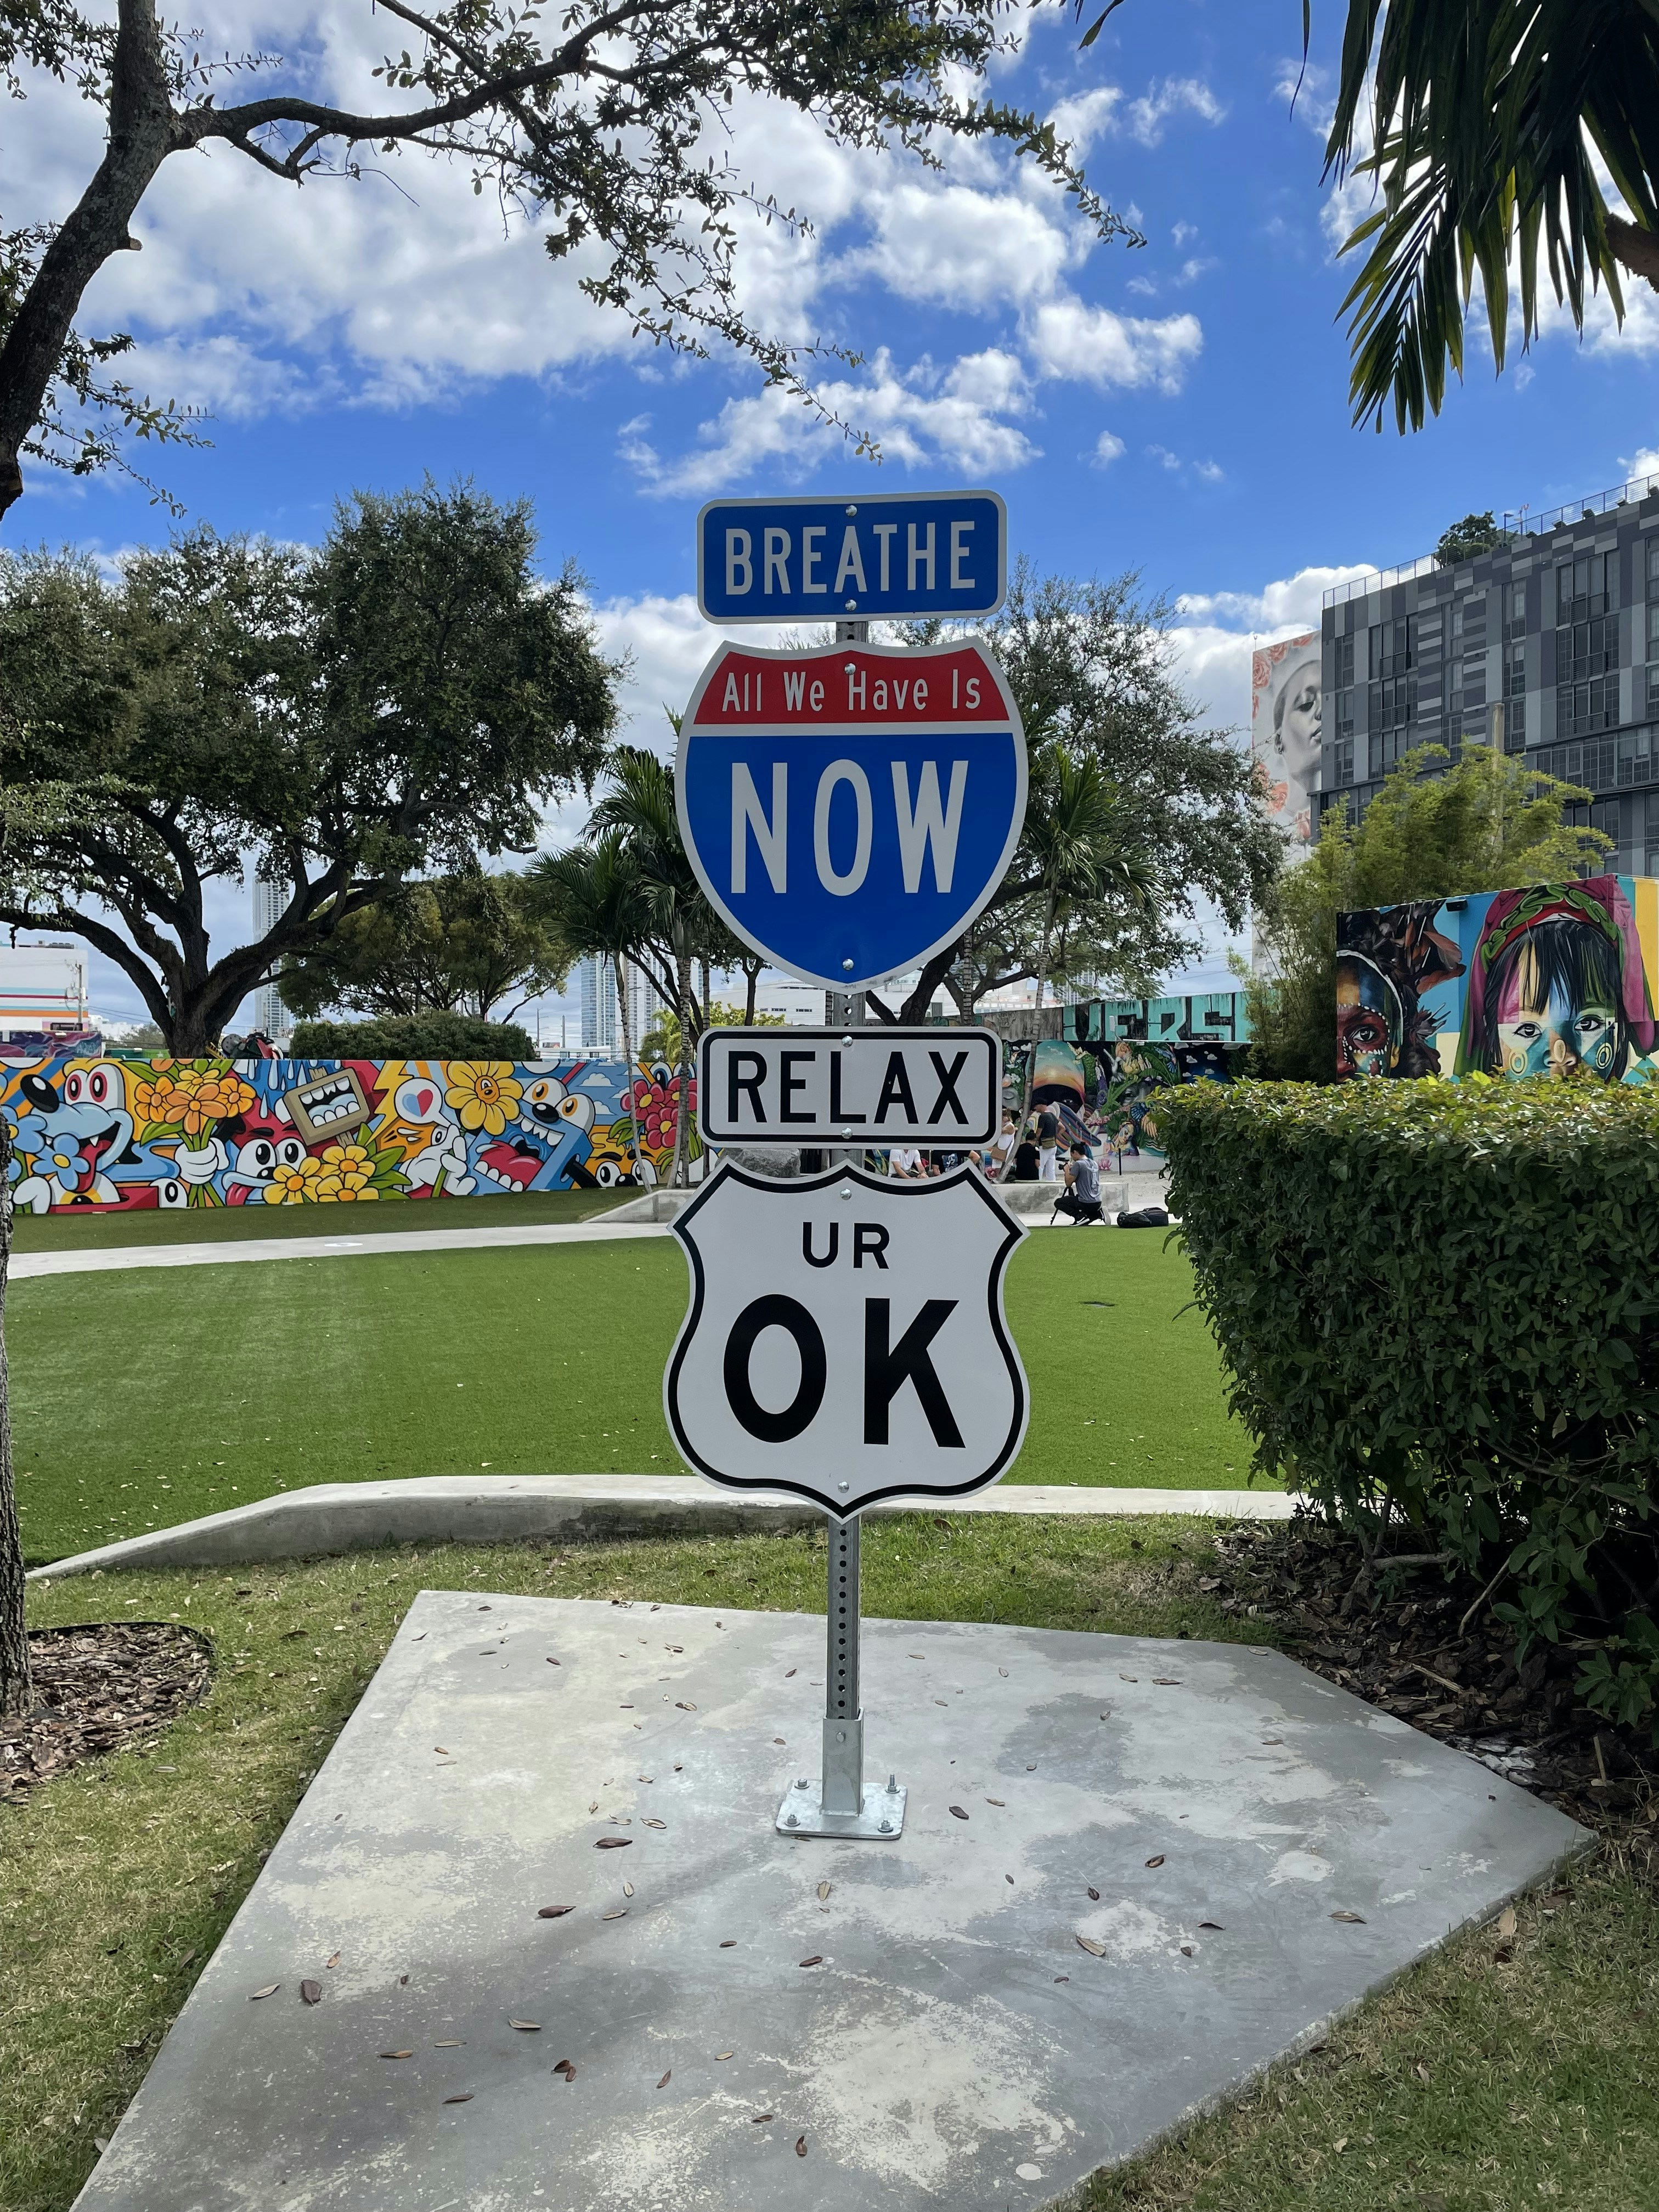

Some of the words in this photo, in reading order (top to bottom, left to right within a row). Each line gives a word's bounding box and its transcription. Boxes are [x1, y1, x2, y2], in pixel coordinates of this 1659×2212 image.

[725, 521, 975, 595] BREATHE
[722, 672, 762, 712] All
[783, 671, 825, 712] We
[849, 670, 928, 710] Have
[952, 669, 981, 709] Is
[731, 759, 969, 896] NOW
[727, 1050, 970, 1125] RELAX
[802, 1221, 890, 1269] UR
[723, 1294, 967, 1449] OK
